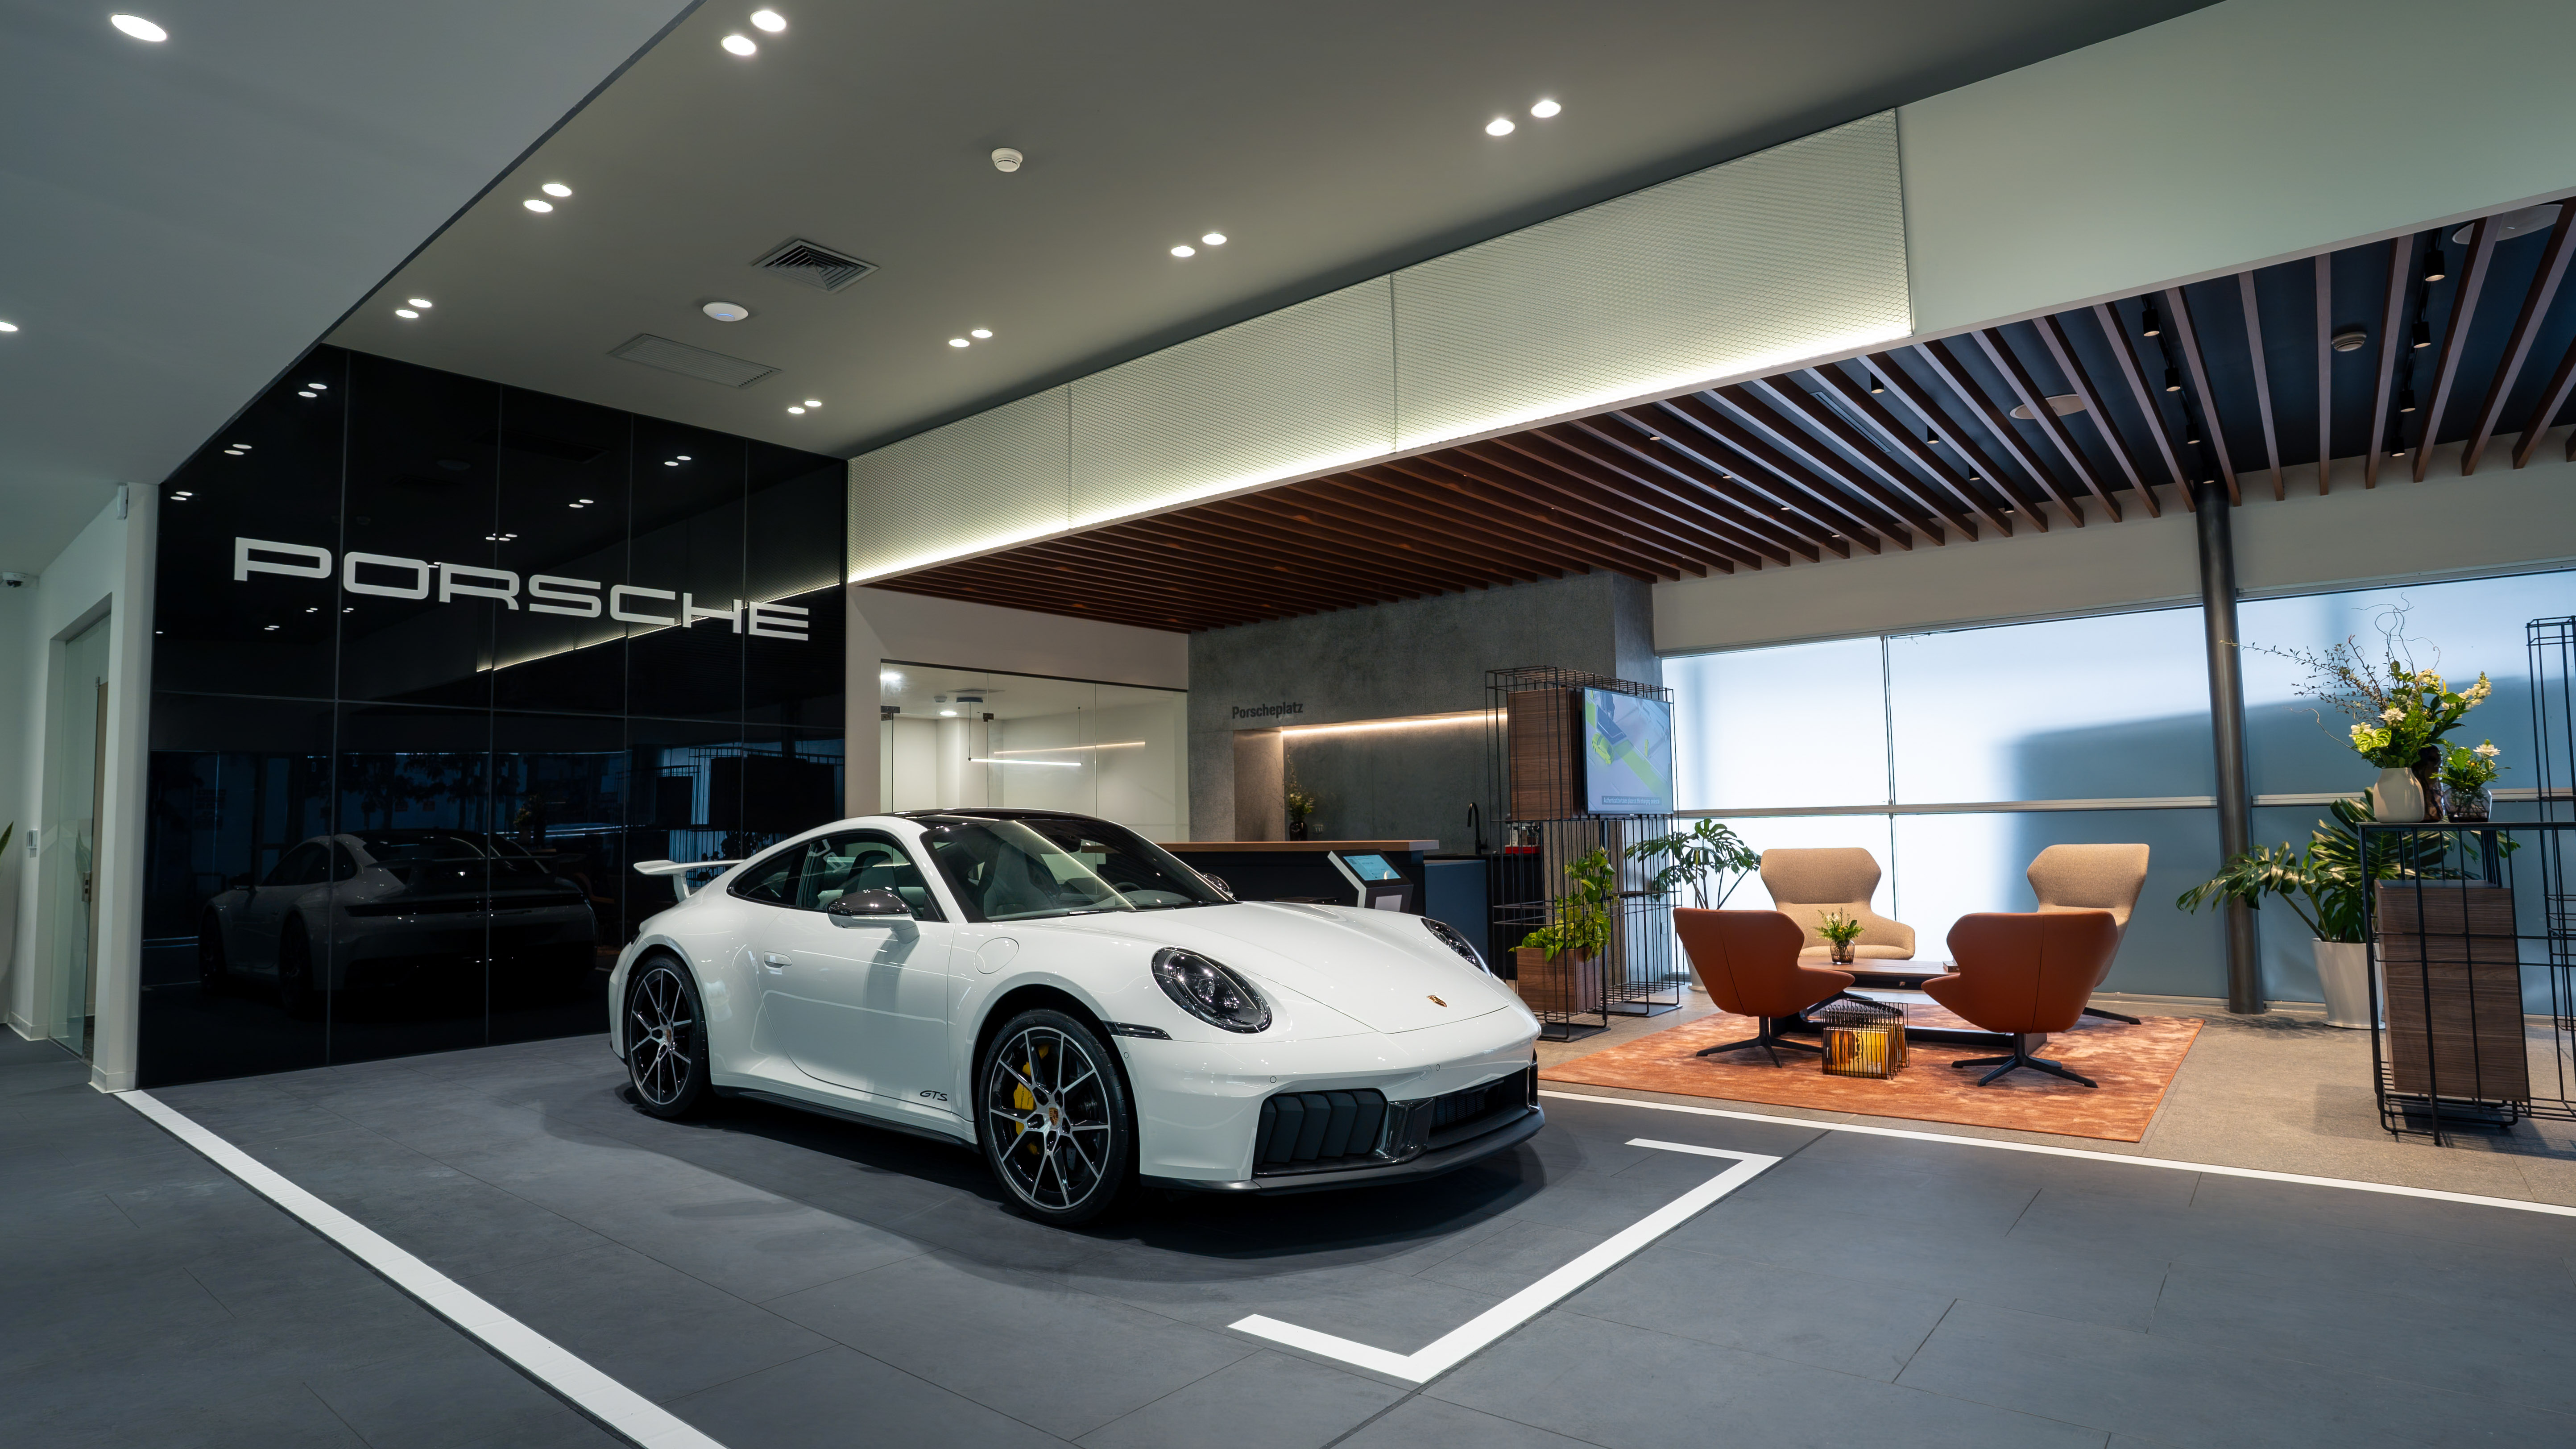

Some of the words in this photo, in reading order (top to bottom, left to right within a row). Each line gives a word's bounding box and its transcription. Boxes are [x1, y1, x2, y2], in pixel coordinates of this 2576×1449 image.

[234, 536, 809, 641] PORSCHE
[1232, 702, 1303, 719] Porscheplatz
[919, 1090, 948, 1101] GTS
